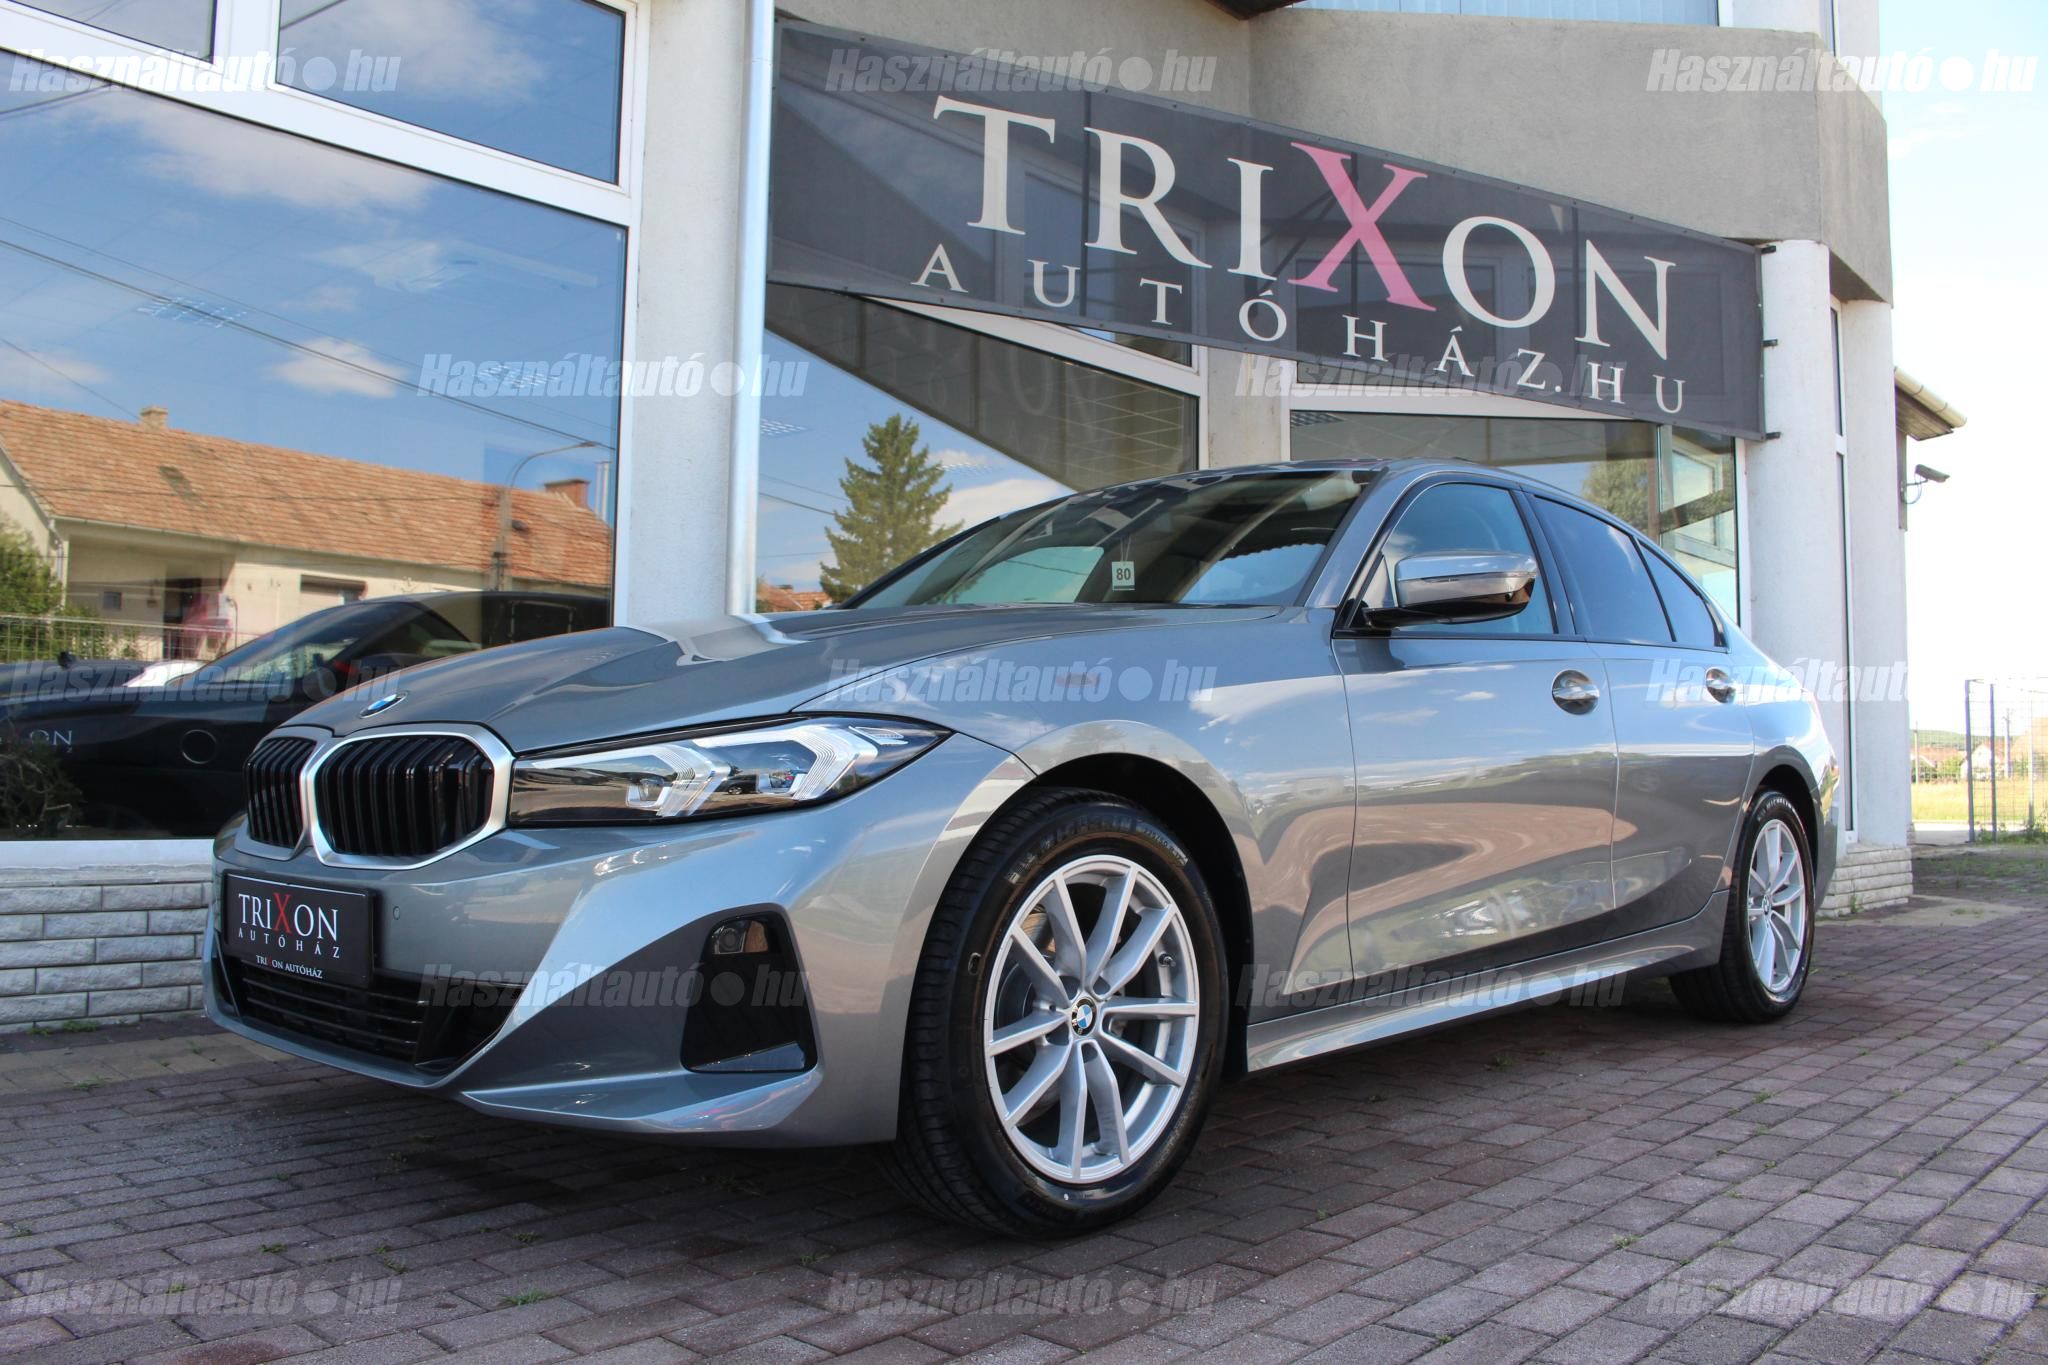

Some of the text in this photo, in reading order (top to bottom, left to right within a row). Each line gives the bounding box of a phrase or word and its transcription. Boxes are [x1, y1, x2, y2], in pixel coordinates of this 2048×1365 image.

[933, 95, 1676, 361] TRIXON
[1116, 568, 1131, 580] 80
[238, 892, 339, 942] TRIXON
[238, 927, 340, 959] AUTÓHÁZ
[284, 964, 323, 979] AUTÓHÁZ
